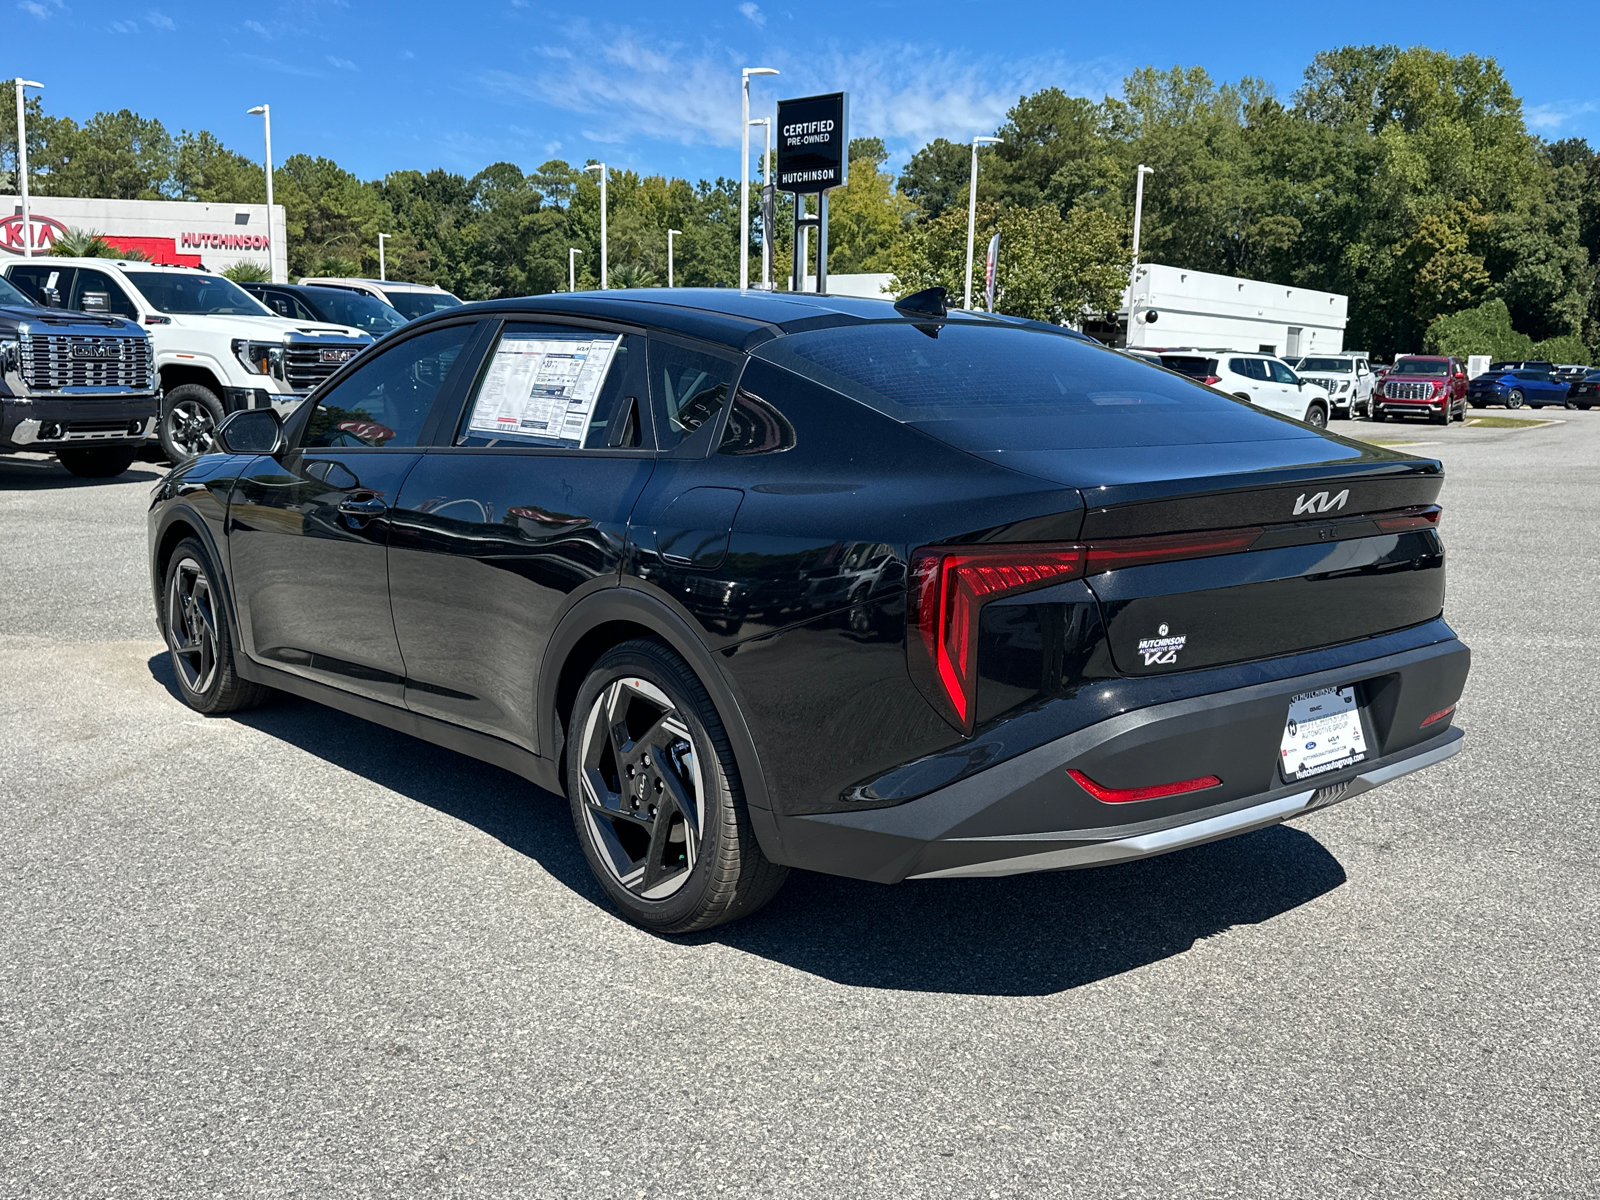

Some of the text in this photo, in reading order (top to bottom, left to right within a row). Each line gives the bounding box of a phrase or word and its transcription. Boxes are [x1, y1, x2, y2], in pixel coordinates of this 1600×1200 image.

[783, 119, 835, 137] CERTIFIED
[787, 134, 830, 147] PRE-OWNED
[782, 169, 835, 184] HUTCHINSON
[181, 232, 270, 250] HUTCHINSON
[73, 345, 121, 357] GMC
[1292, 489, 1350, 516] KIA
[1138, 636, 1186, 649] HUTCHINSON
[1139, 646, 1168, 655] AUTOMOTIVE
[1144, 651, 1177, 666] K4
[1302, 721, 1349, 739] AUTOMOTIVE GROUP
[1295, 753, 1365, 780] Hutchinsonautogroup.com
